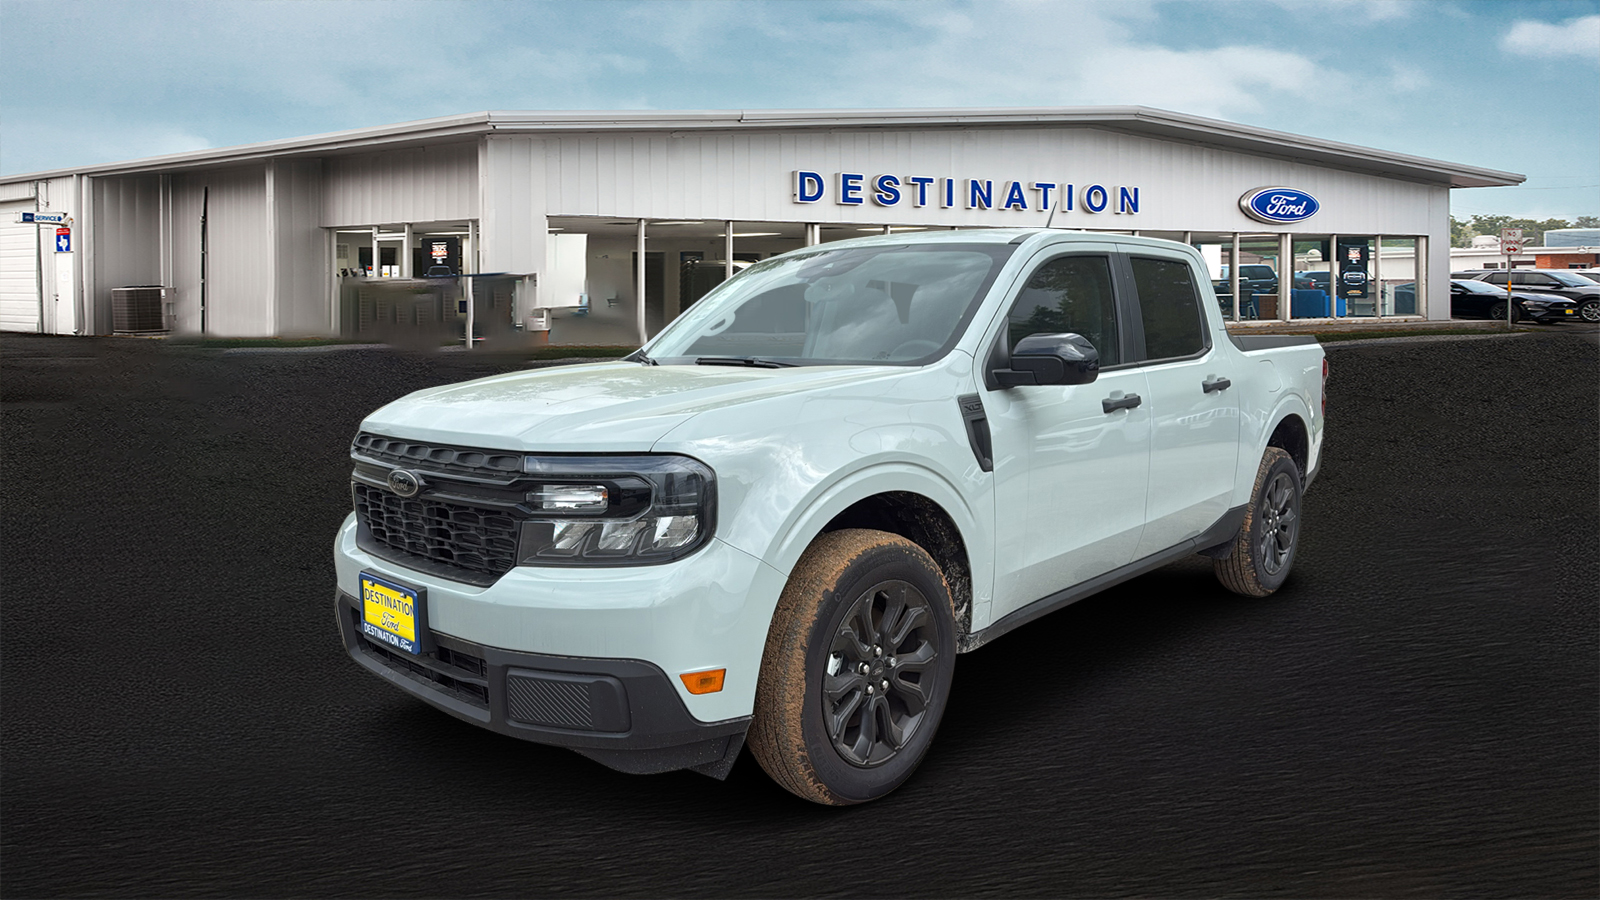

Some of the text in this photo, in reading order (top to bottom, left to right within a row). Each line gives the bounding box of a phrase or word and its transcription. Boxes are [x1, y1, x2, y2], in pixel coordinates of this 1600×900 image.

[794, 170, 1142, 214] DESTINATION
[1266, 194, 1307, 215] Ford
[965, 403, 983, 411] XLT
[392, 474, 408, 491] Ford
[365, 588, 413, 617] DESTINATION
[381, 611, 400, 632] Ford
[364, 623, 413, 652] DESTINATION Ford
